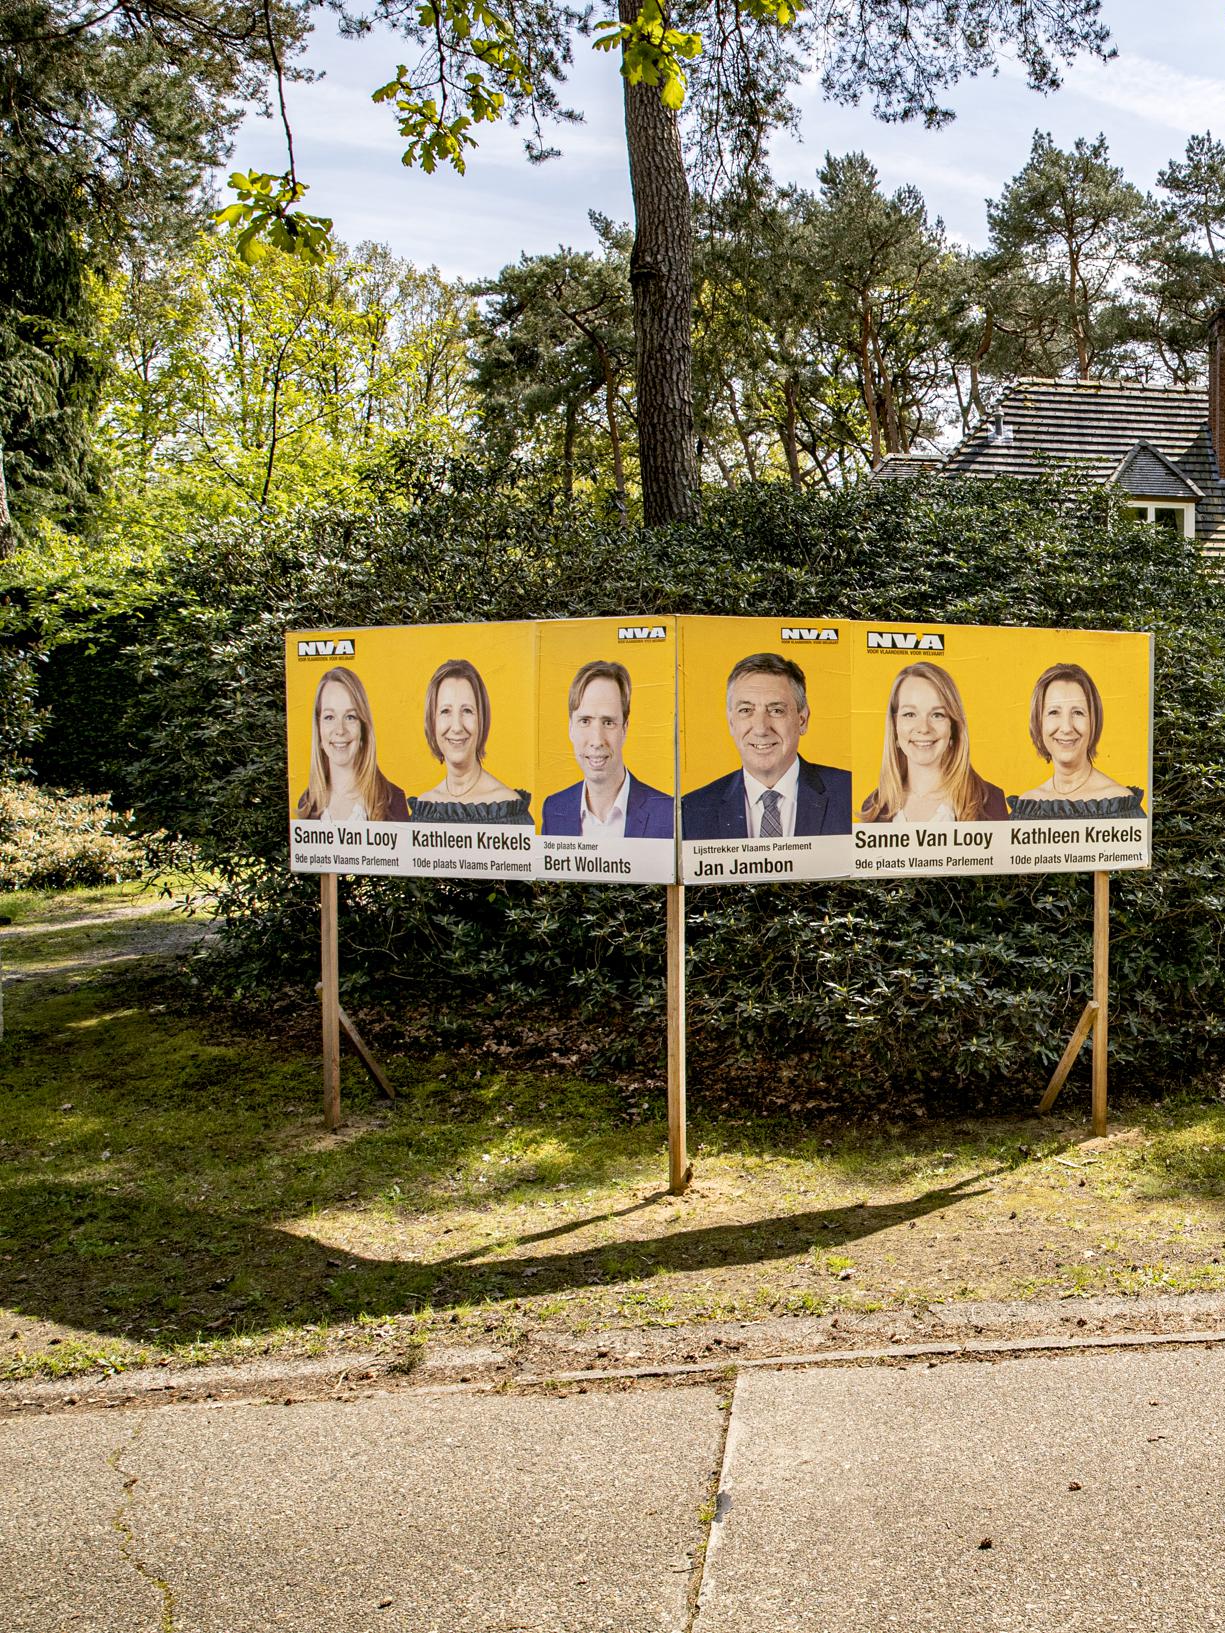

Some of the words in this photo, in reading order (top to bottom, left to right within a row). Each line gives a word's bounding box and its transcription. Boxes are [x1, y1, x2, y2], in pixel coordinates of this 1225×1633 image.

[294, 826, 334, 845] Sanne
[337, 827, 362, 845] Van
[366, 828, 397, 850] Looy
[412, 830, 472, 849] Kathleen
[477, 831, 531, 851] Krekels
[855, 830, 910, 849] Sanne
[916, 829, 947, 847] Van
[953, 829, 993, 849] Looy
[1011, 827, 1080, 845] Kathleen
[1085, 826, 1142, 843] Krekels
[543, 841, 555, 850] 3de
[556, 842, 576, 851] plaats
[577, 842, 598, 850] Kamer
[693, 845, 739, 856] Lijsttrekker
[741, 844, 771, 853] Vlaams
[772, 842, 812, 851] Parlement
[295, 853, 308, 863] 9de
[309, 854, 331, 865] plaats
[333, 855, 360, 866] Vlaams
[361, 856, 399, 867] Parlement
[412, 858, 431, 868] 10de
[433, 858, 457, 870] plaats
[459, 859, 488, 870] Vlaams
[490, 860, 532, 872] Parlement
[544, 855, 571, 871] Bert
[575, 856, 631, 874] Wollants
[694, 860, 724, 876] Jan
[729, 858, 793, 875] Jambon
[855, 859, 873, 869] 9de
[876, 858, 906, 870] plaats
[908, 857, 943, 868] Vlaams
[946, 856, 994, 867] Parlement
[1010, 855, 1031, 865] 10de
[1034, 854, 1061, 866] plaats
[1064, 853, 1096, 863] Vlaams
[1098, 852, 1143, 862] Parlement
